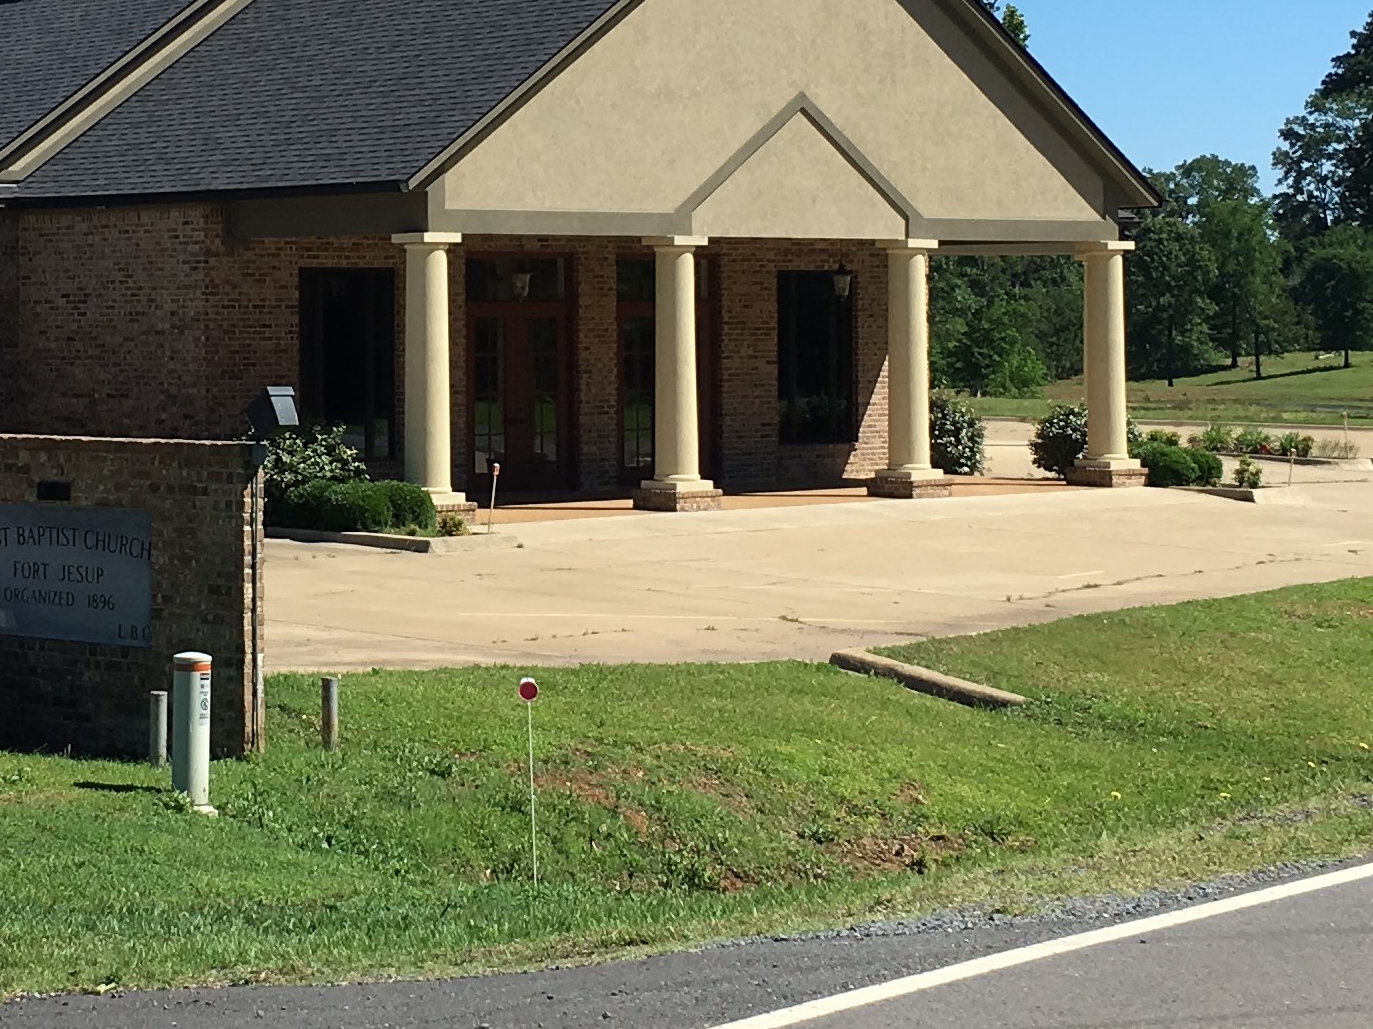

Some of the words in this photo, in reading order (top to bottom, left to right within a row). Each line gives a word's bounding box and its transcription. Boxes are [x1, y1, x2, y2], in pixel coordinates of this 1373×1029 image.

[17, 526, 80, 547] BAPTIST
[83, 530, 152, 561] CHURCH
[13, 561, 50, 580] FORT
[57, 564, 105, 584] JESUP
[4, 587, 75, 607] ORGANIZED
[87, 594, 115, 611] 1896
